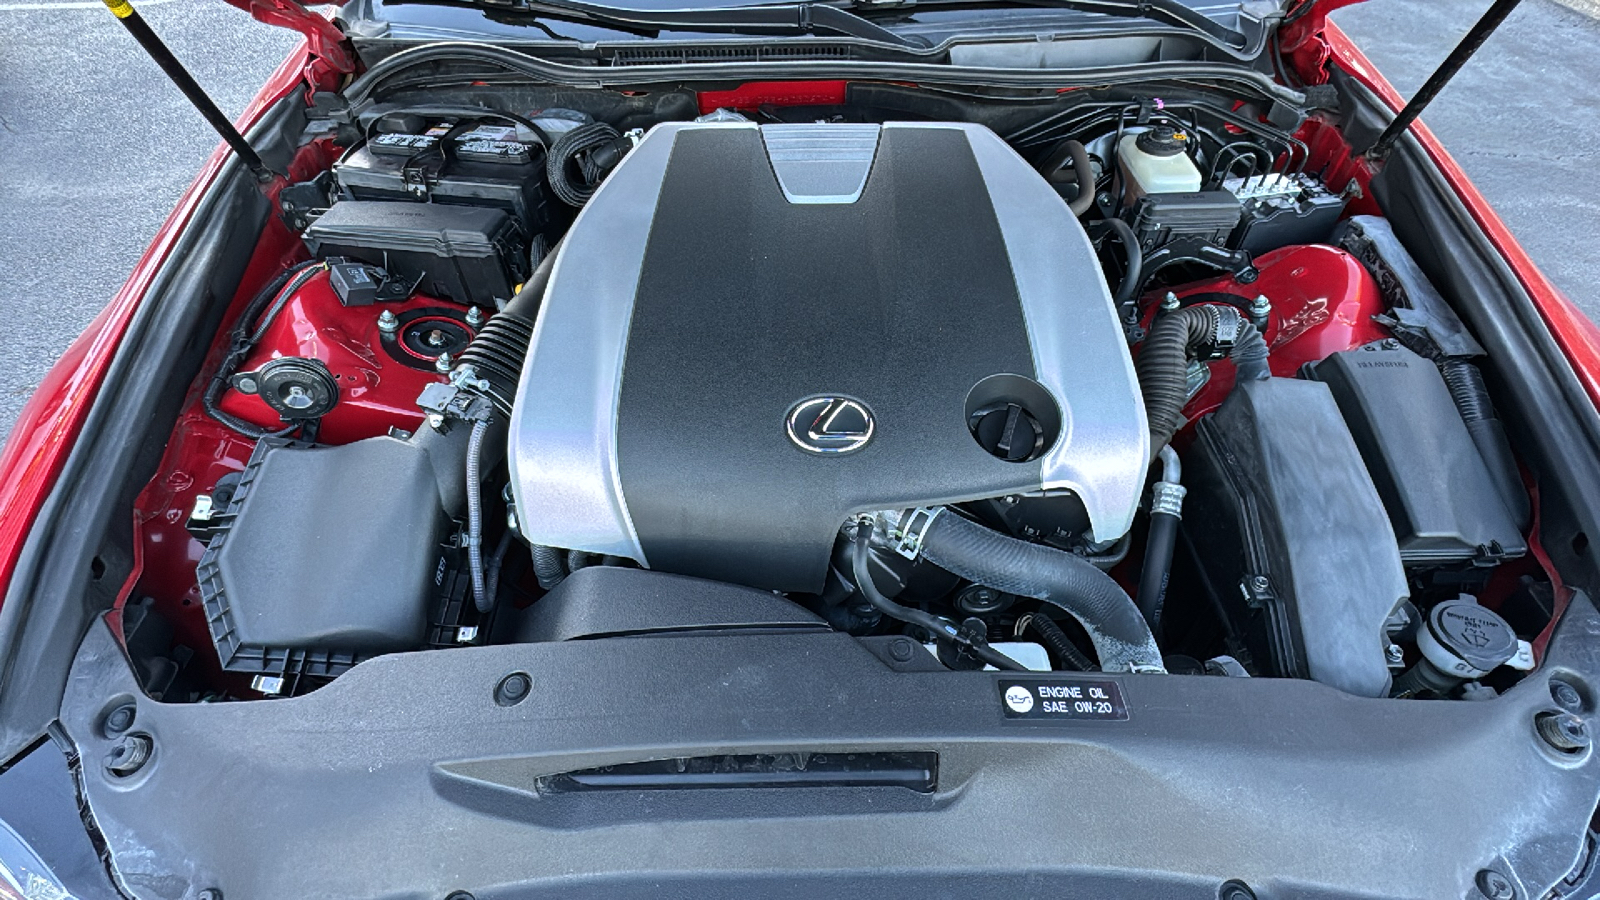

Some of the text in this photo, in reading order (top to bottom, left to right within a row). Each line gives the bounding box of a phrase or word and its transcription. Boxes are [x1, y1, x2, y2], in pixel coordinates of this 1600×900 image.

[1038, 686, 1109, 699] ENGINE OIL
[1042, 701, 1113, 714] SAE 0W-20
